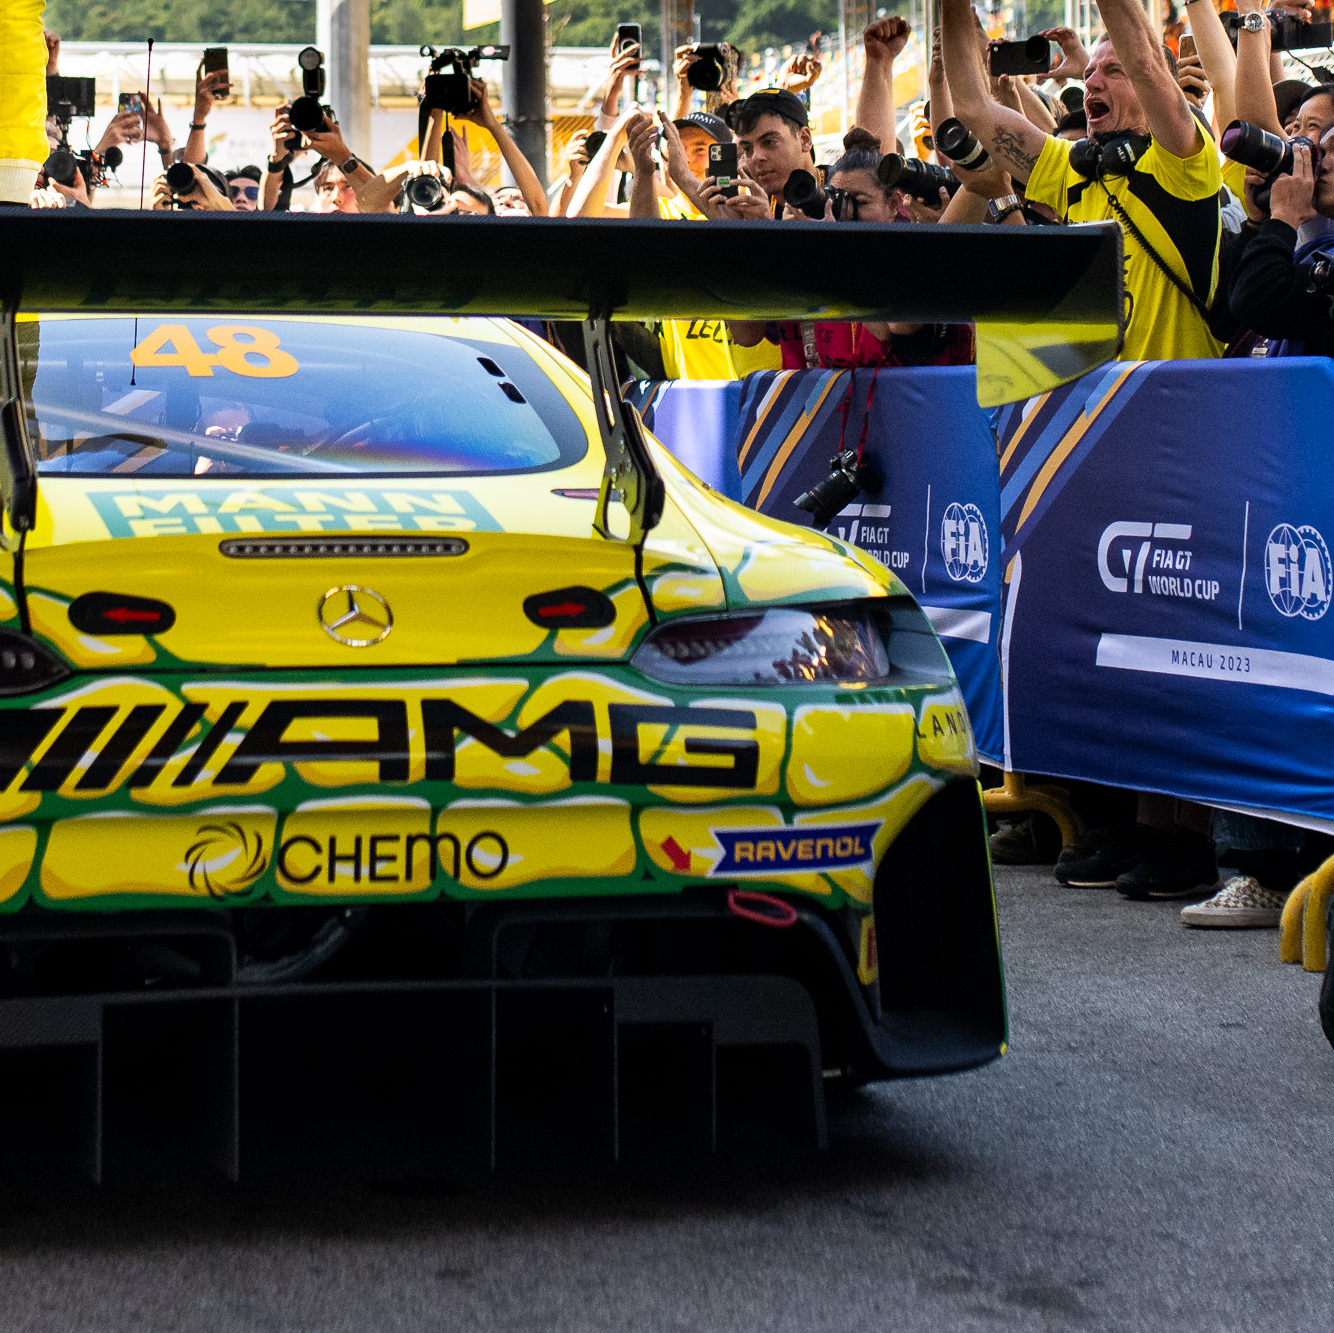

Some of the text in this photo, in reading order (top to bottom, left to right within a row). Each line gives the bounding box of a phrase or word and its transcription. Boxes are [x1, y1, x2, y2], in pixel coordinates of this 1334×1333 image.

[130, 324, 299, 379] 48
[112, 491, 468, 517] MANN
[860, 526, 877, 544] FIA
[877, 527, 890, 545] GT
[891, 551, 910, 569] CUP
[1152, 548, 1174, 569] FIA
[1175, 550, 1193, 571] GT
[1148, 575, 1220, 601] WORLD CUP
[1171, 649, 1251, 673] MACAU 2023
[278, 831, 509, 884] CHEMO
[734, 836, 866, 863] RAVENOL
